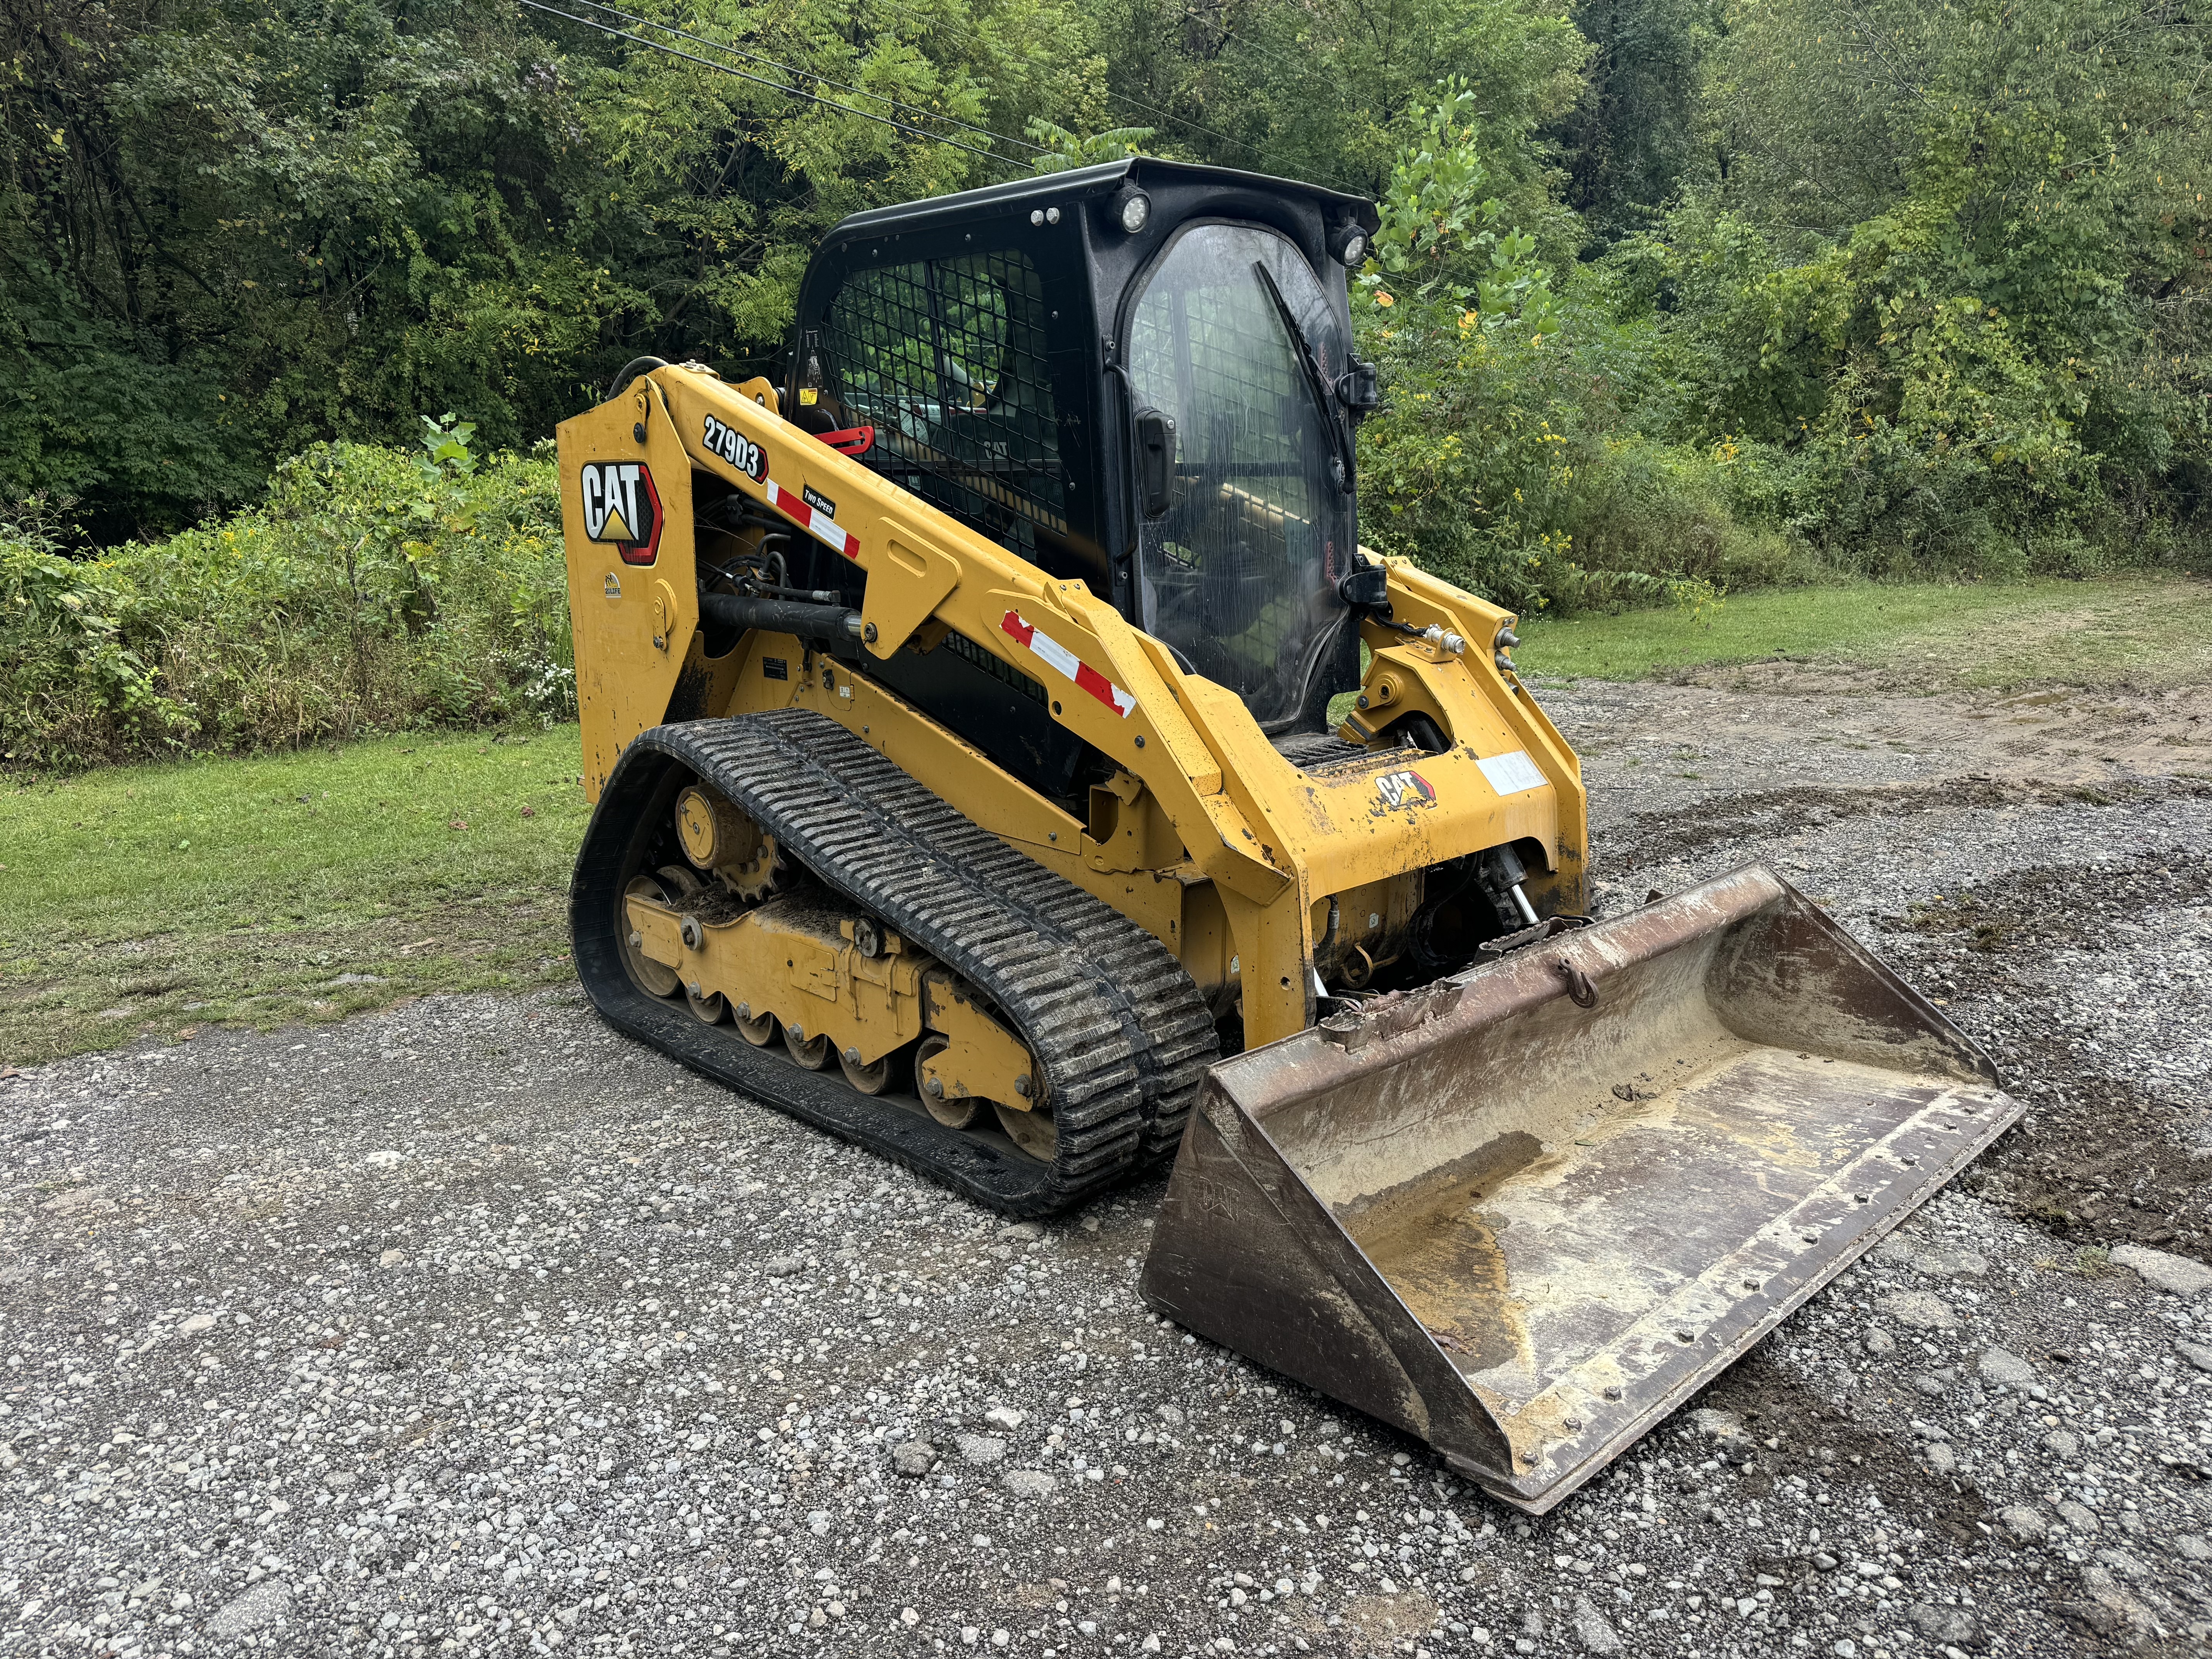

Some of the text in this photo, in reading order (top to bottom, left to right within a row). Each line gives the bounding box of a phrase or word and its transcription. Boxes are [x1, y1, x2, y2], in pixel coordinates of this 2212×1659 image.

[704, 416, 759, 477] 279D3
[984, 441, 1007, 460] CAT
[582, 465, 640, 540] CAT
[1375, 771, 1414, 806] CAT
[1199, 1176, 1241, 1221] CAT
